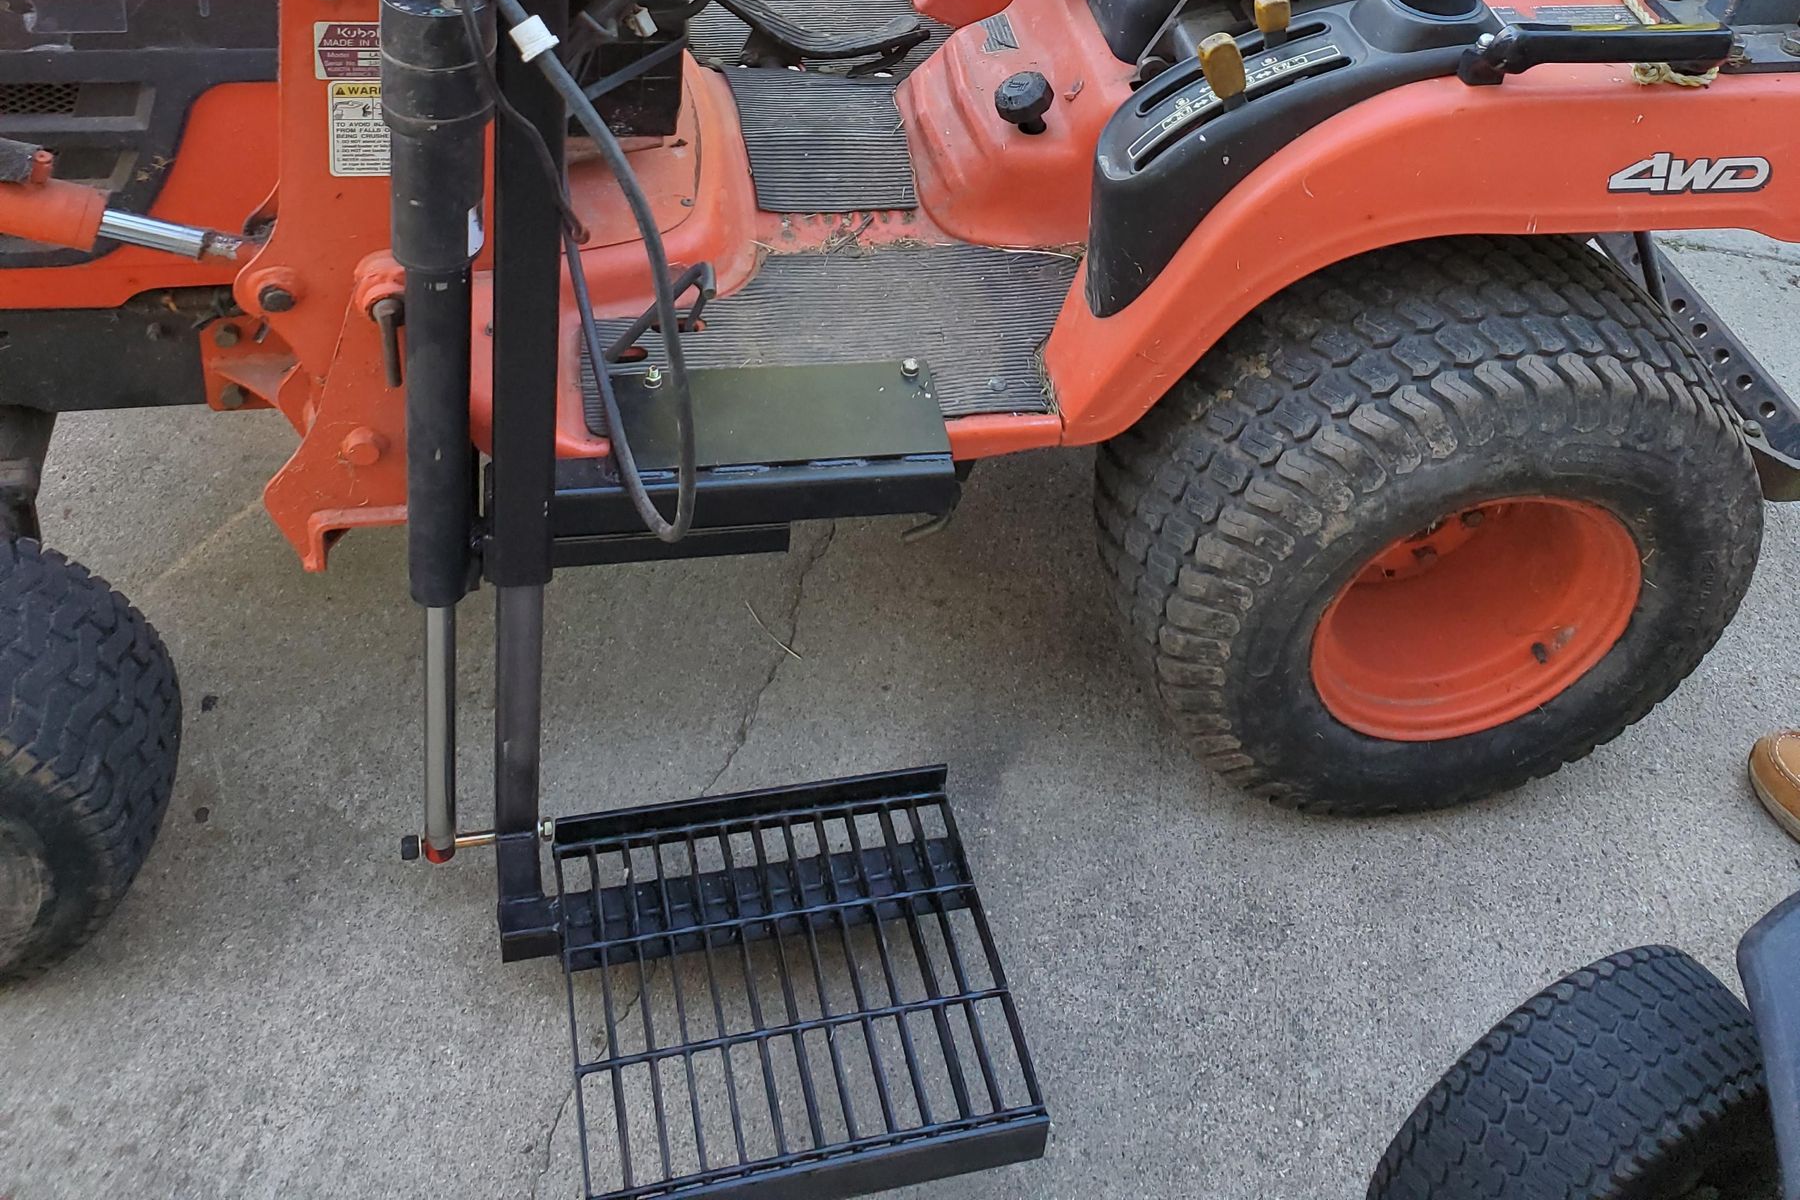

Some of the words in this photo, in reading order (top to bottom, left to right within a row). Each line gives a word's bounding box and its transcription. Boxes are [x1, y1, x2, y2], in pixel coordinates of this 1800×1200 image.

[323, 39, 354, 47] MADE
[359, 39, 371, 47] IN
[1608, 152, 1772, 194] 4WD
